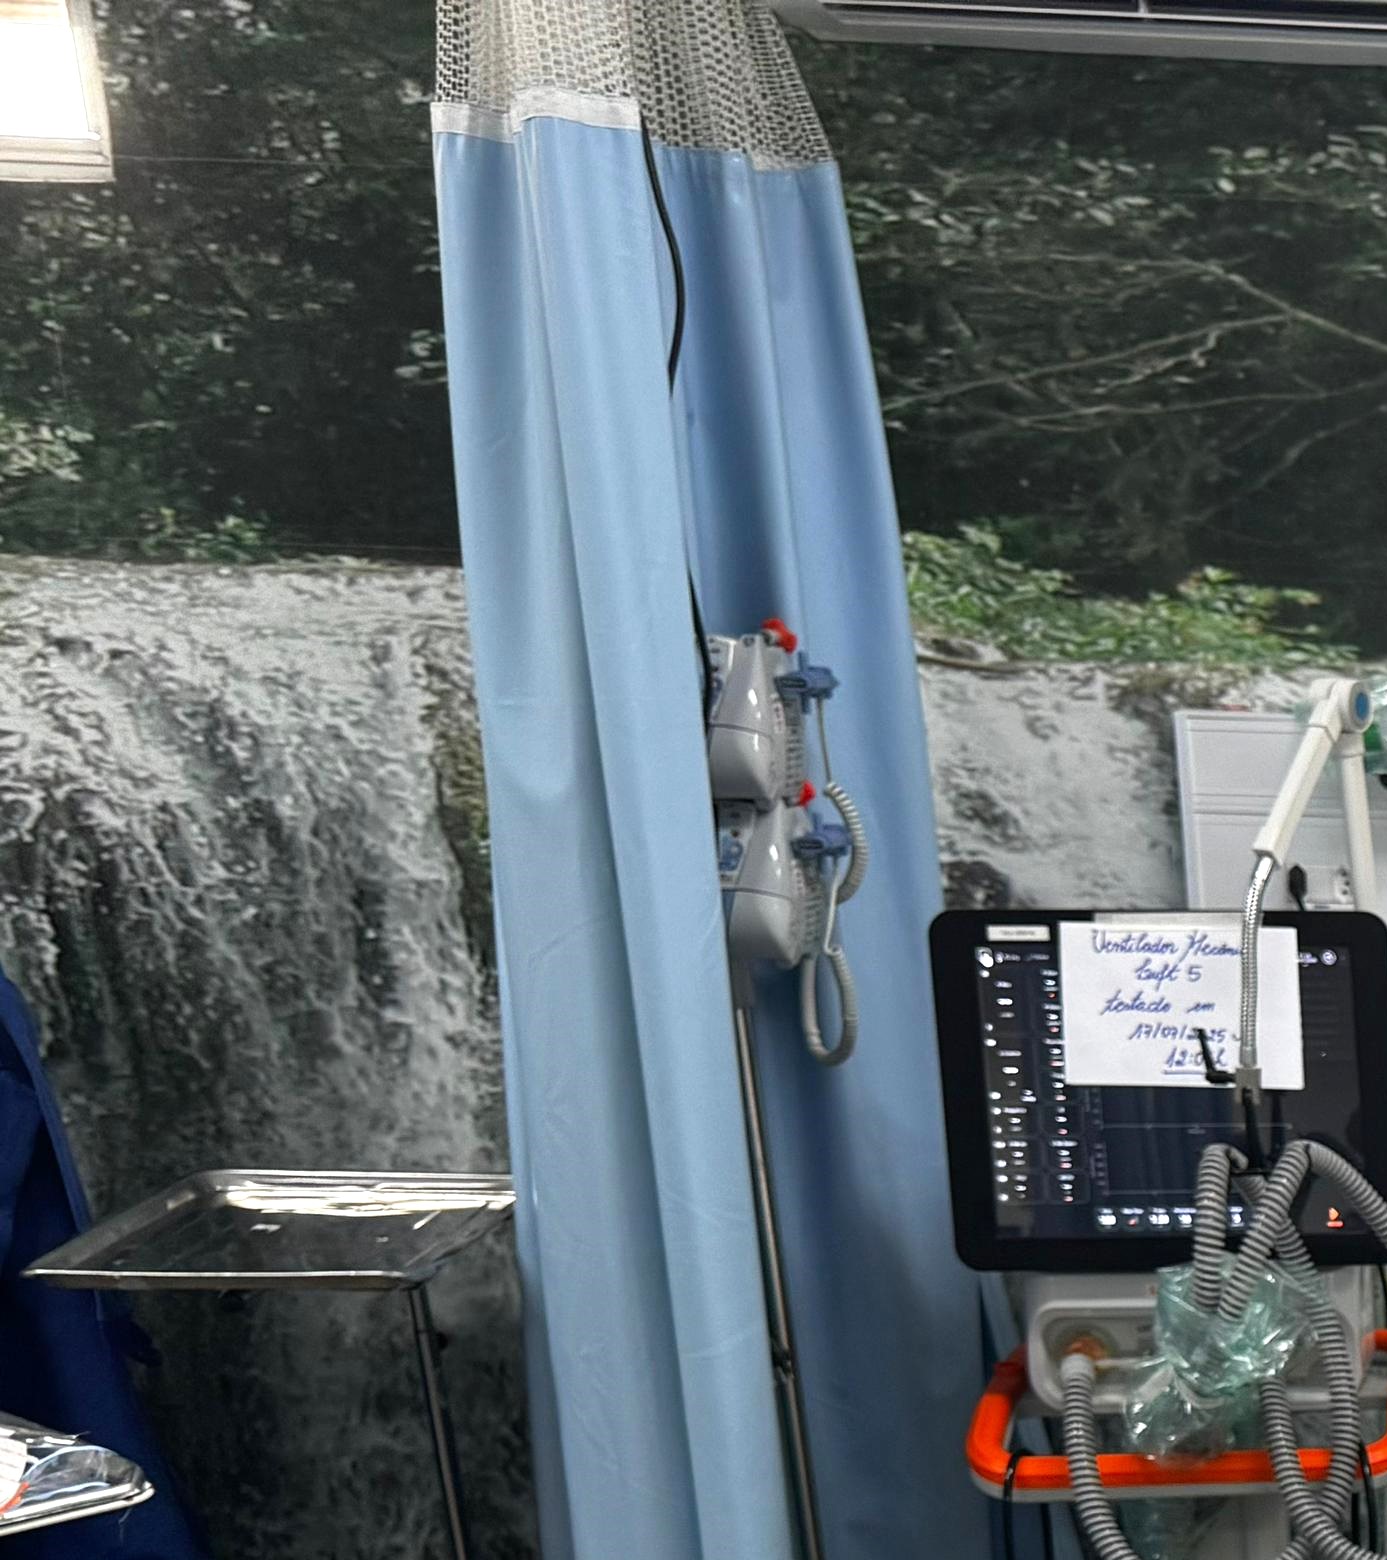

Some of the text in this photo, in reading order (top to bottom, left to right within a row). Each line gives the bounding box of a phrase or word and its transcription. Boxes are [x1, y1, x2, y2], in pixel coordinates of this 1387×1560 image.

[1091, 929, 1178, 955] Ventilador
[1187, 965, 1202, 982] 5
[1129, 1021, 1228, 1044] 17/07/225
